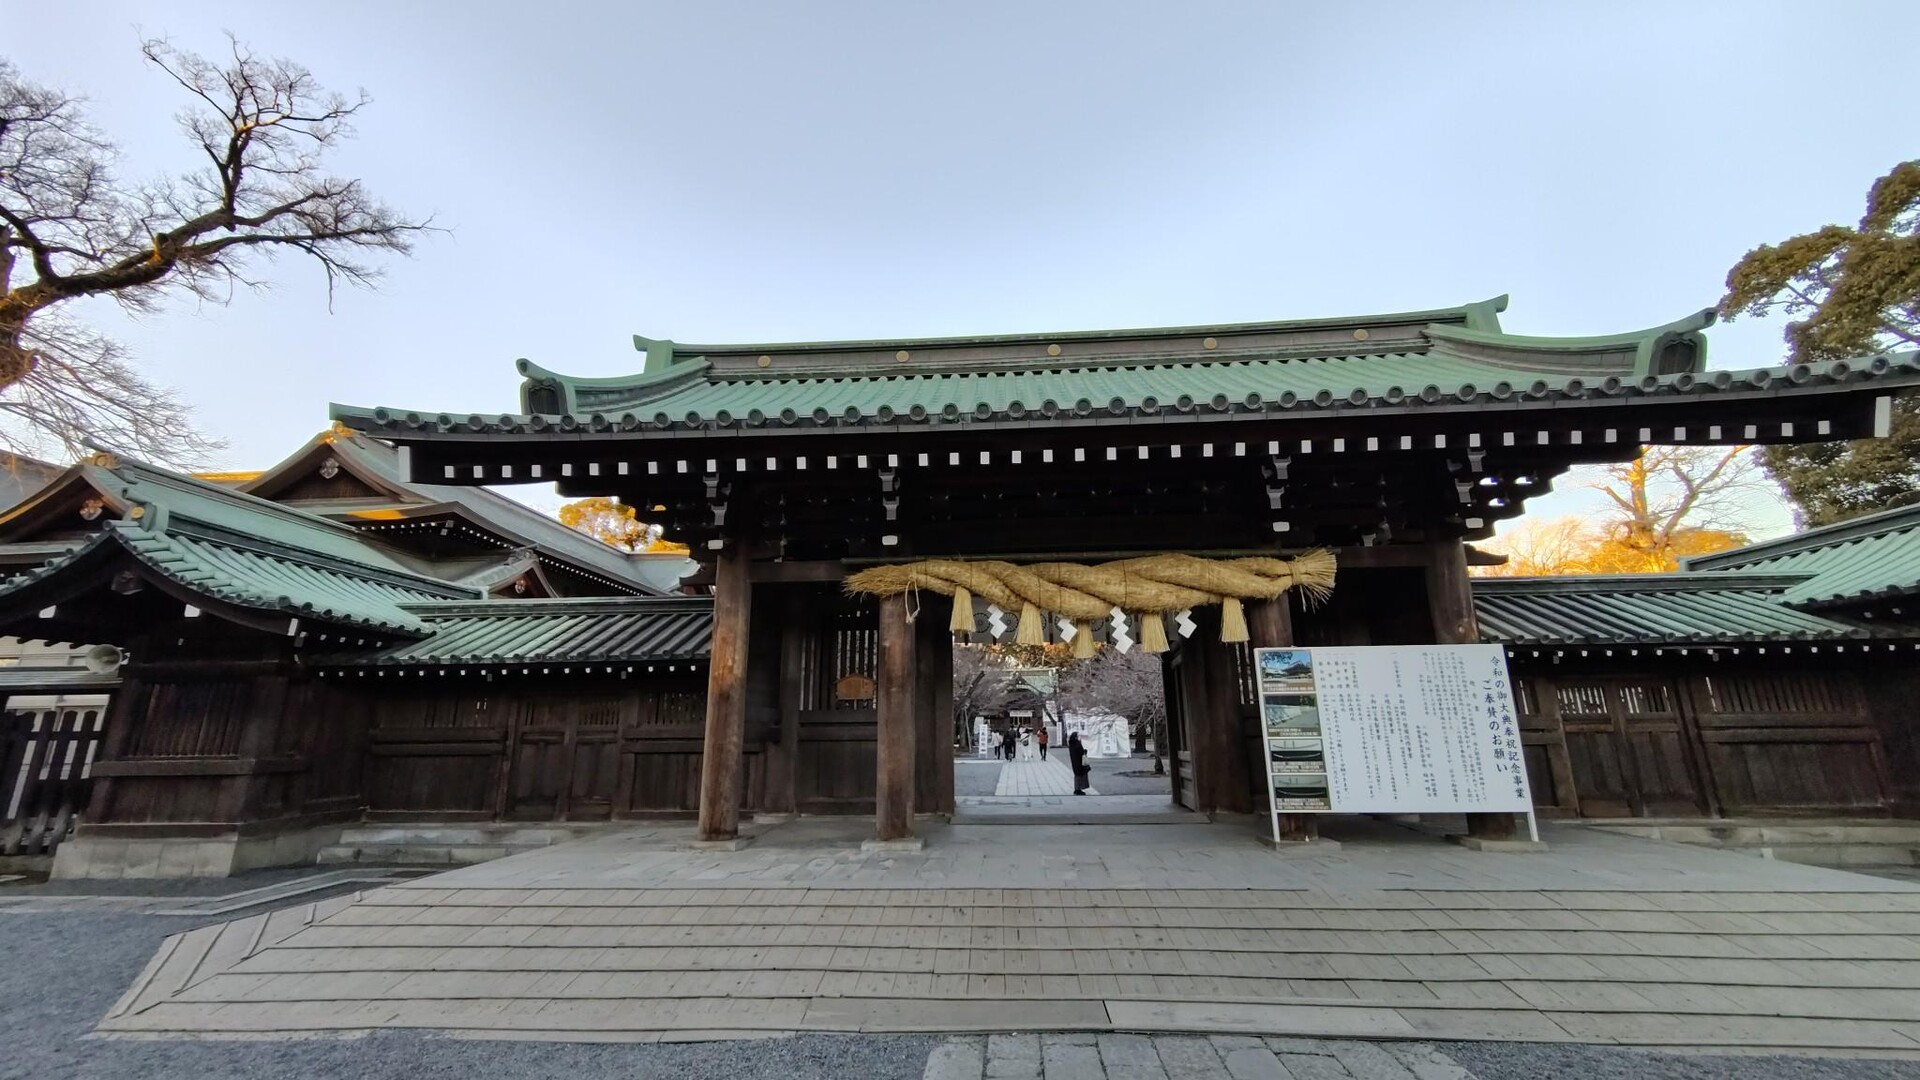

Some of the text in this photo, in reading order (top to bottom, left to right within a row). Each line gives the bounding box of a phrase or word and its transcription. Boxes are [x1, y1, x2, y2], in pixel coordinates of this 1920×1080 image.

[1483, 679, 1507, 772] ご奉賛のお願い
[1491, 656, 1524, 798] 令和の御大典奉祝記念事業
